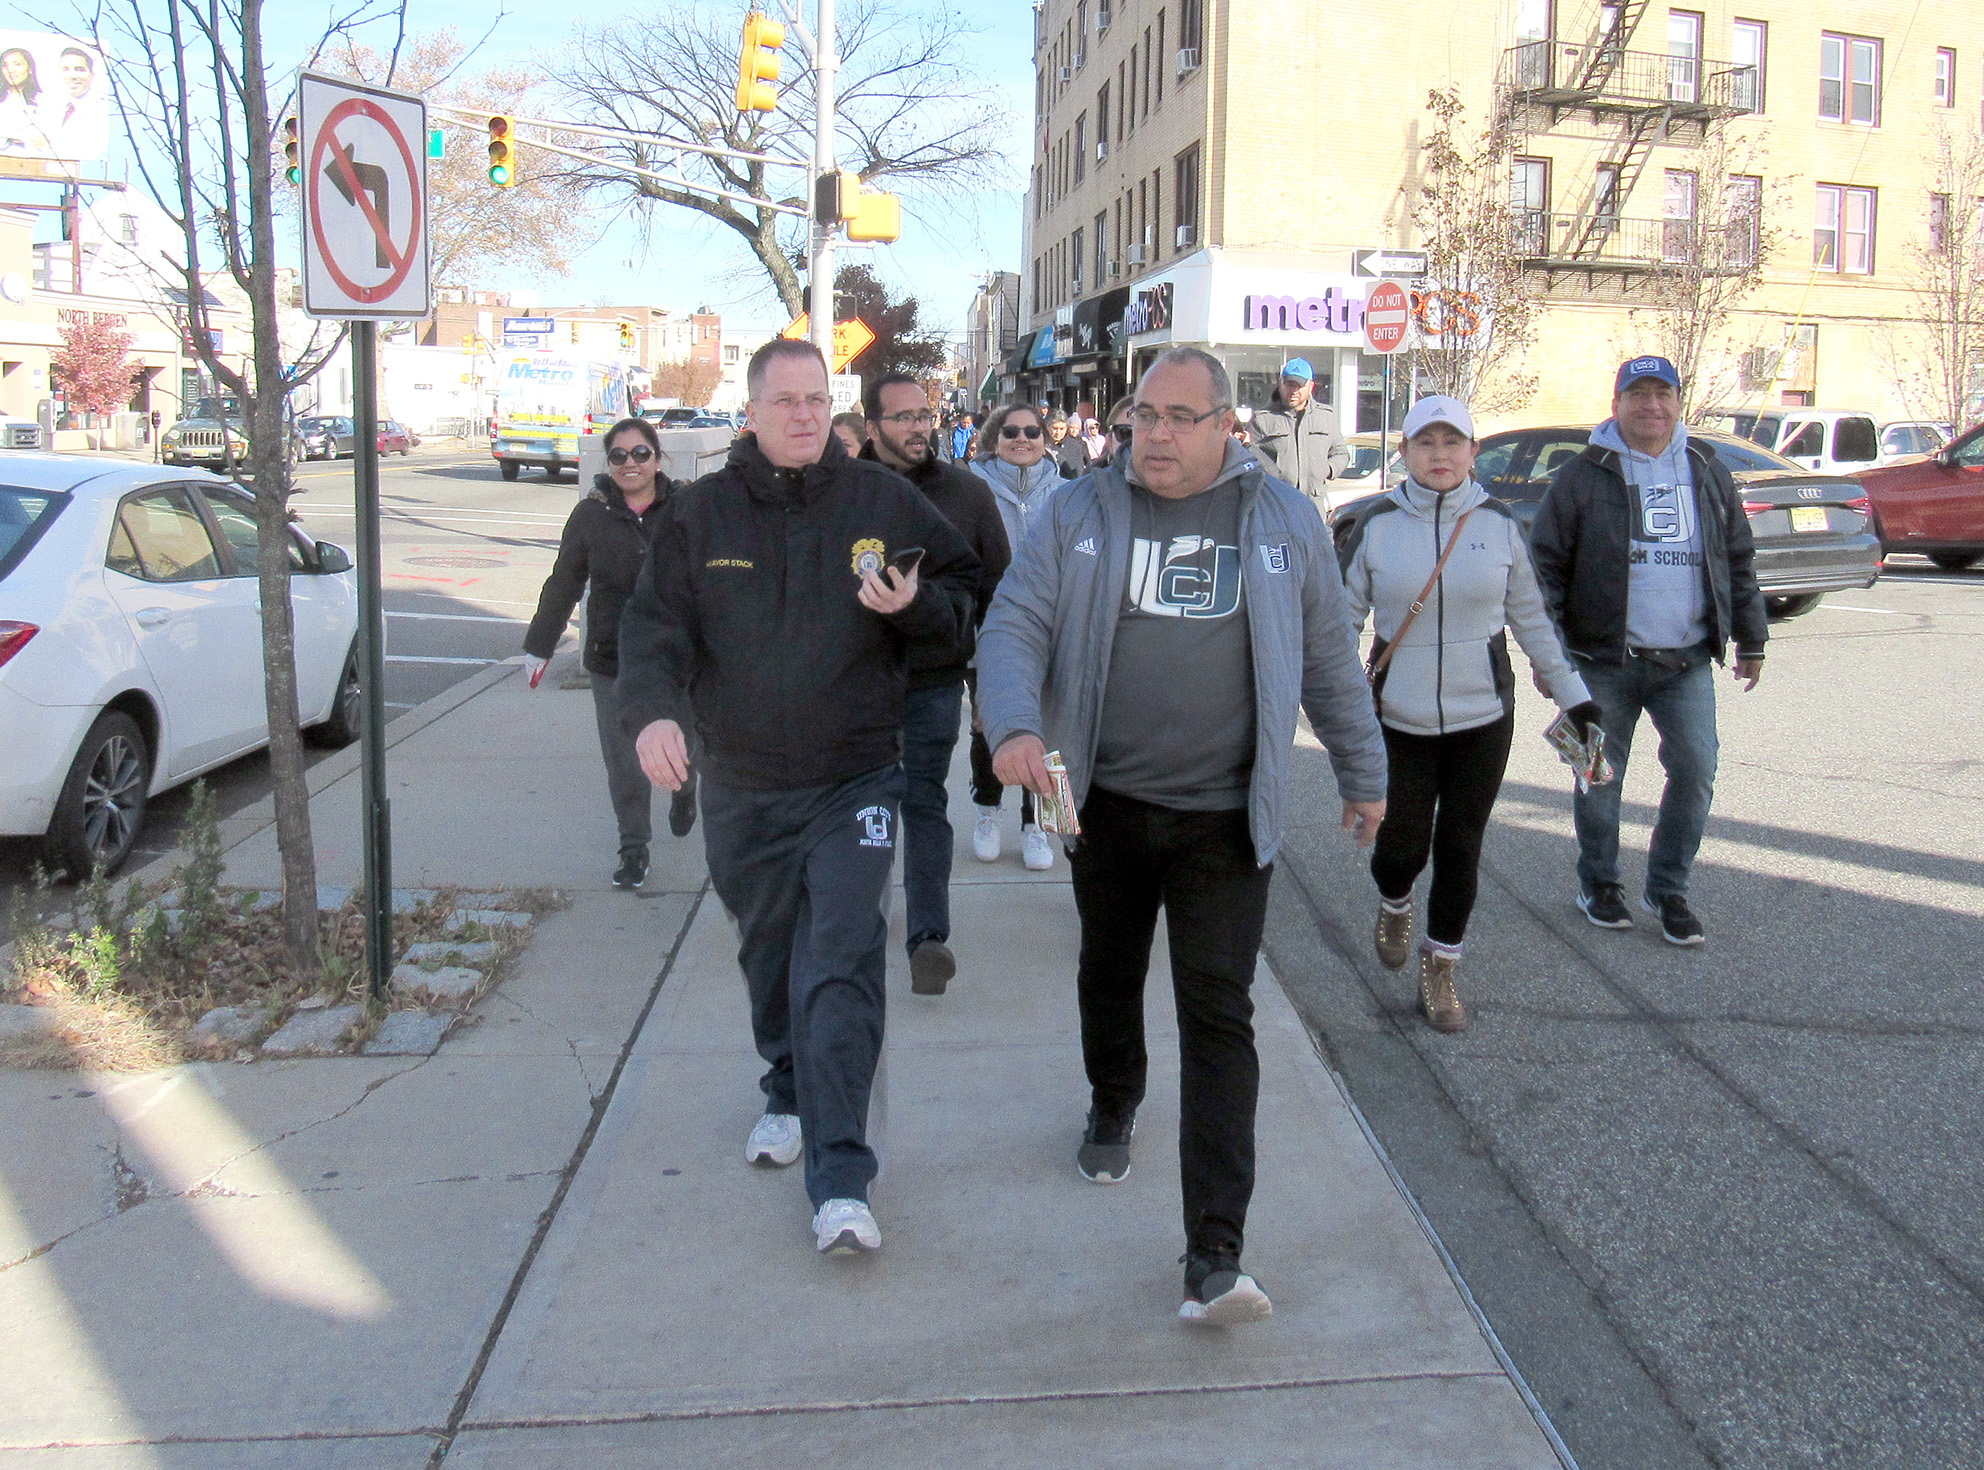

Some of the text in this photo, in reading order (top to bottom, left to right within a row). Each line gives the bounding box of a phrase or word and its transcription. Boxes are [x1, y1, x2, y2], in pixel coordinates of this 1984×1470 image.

[1379, 257, 1424, 271] ONE WAY
[1372, 293, 1402, 308] DO NOT
[57, 308, 89, 325] NORTH
[1373, 327, 1400, 341] ENTER
[507, 363, 574, 381] Metro
[832, 380, 855, 389] FINES
[706, 558, 754, 569] MAYOR STACK
[1654, 549, 1702, 567] SCHOOL
